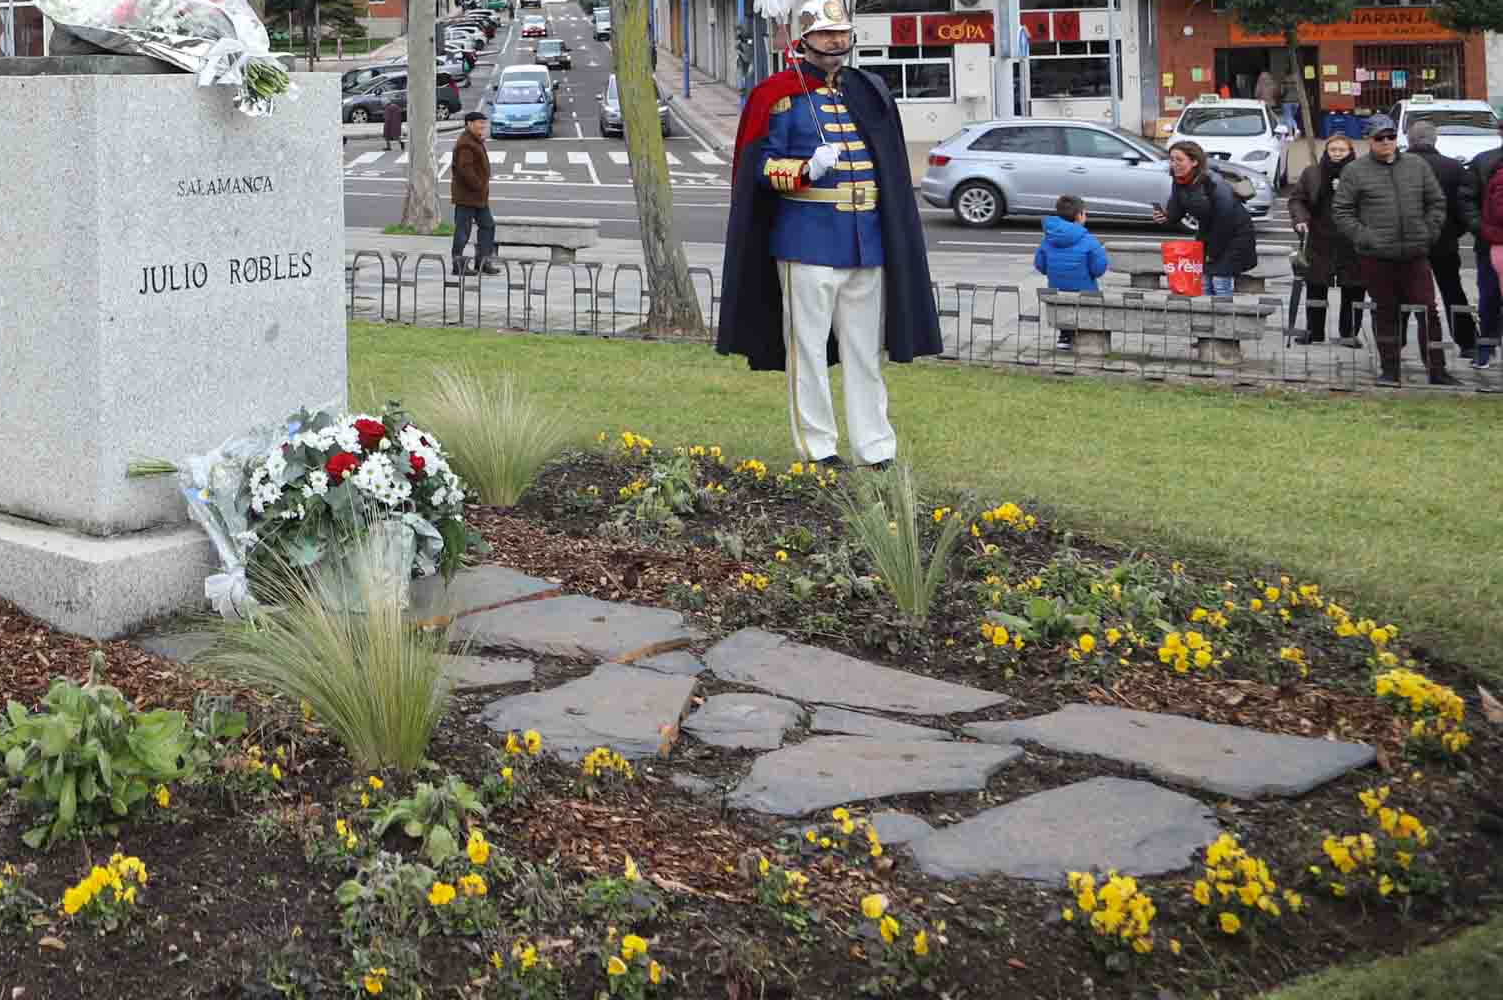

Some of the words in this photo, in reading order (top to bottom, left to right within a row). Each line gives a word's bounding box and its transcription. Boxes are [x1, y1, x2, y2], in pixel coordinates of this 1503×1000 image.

[937, 20, 985, 40] COPA
[176, 176, 274, 197] SALAMANCA
[139, 262, 208, 294] JULIO
[229, 251, 313, 284] ROBLES
